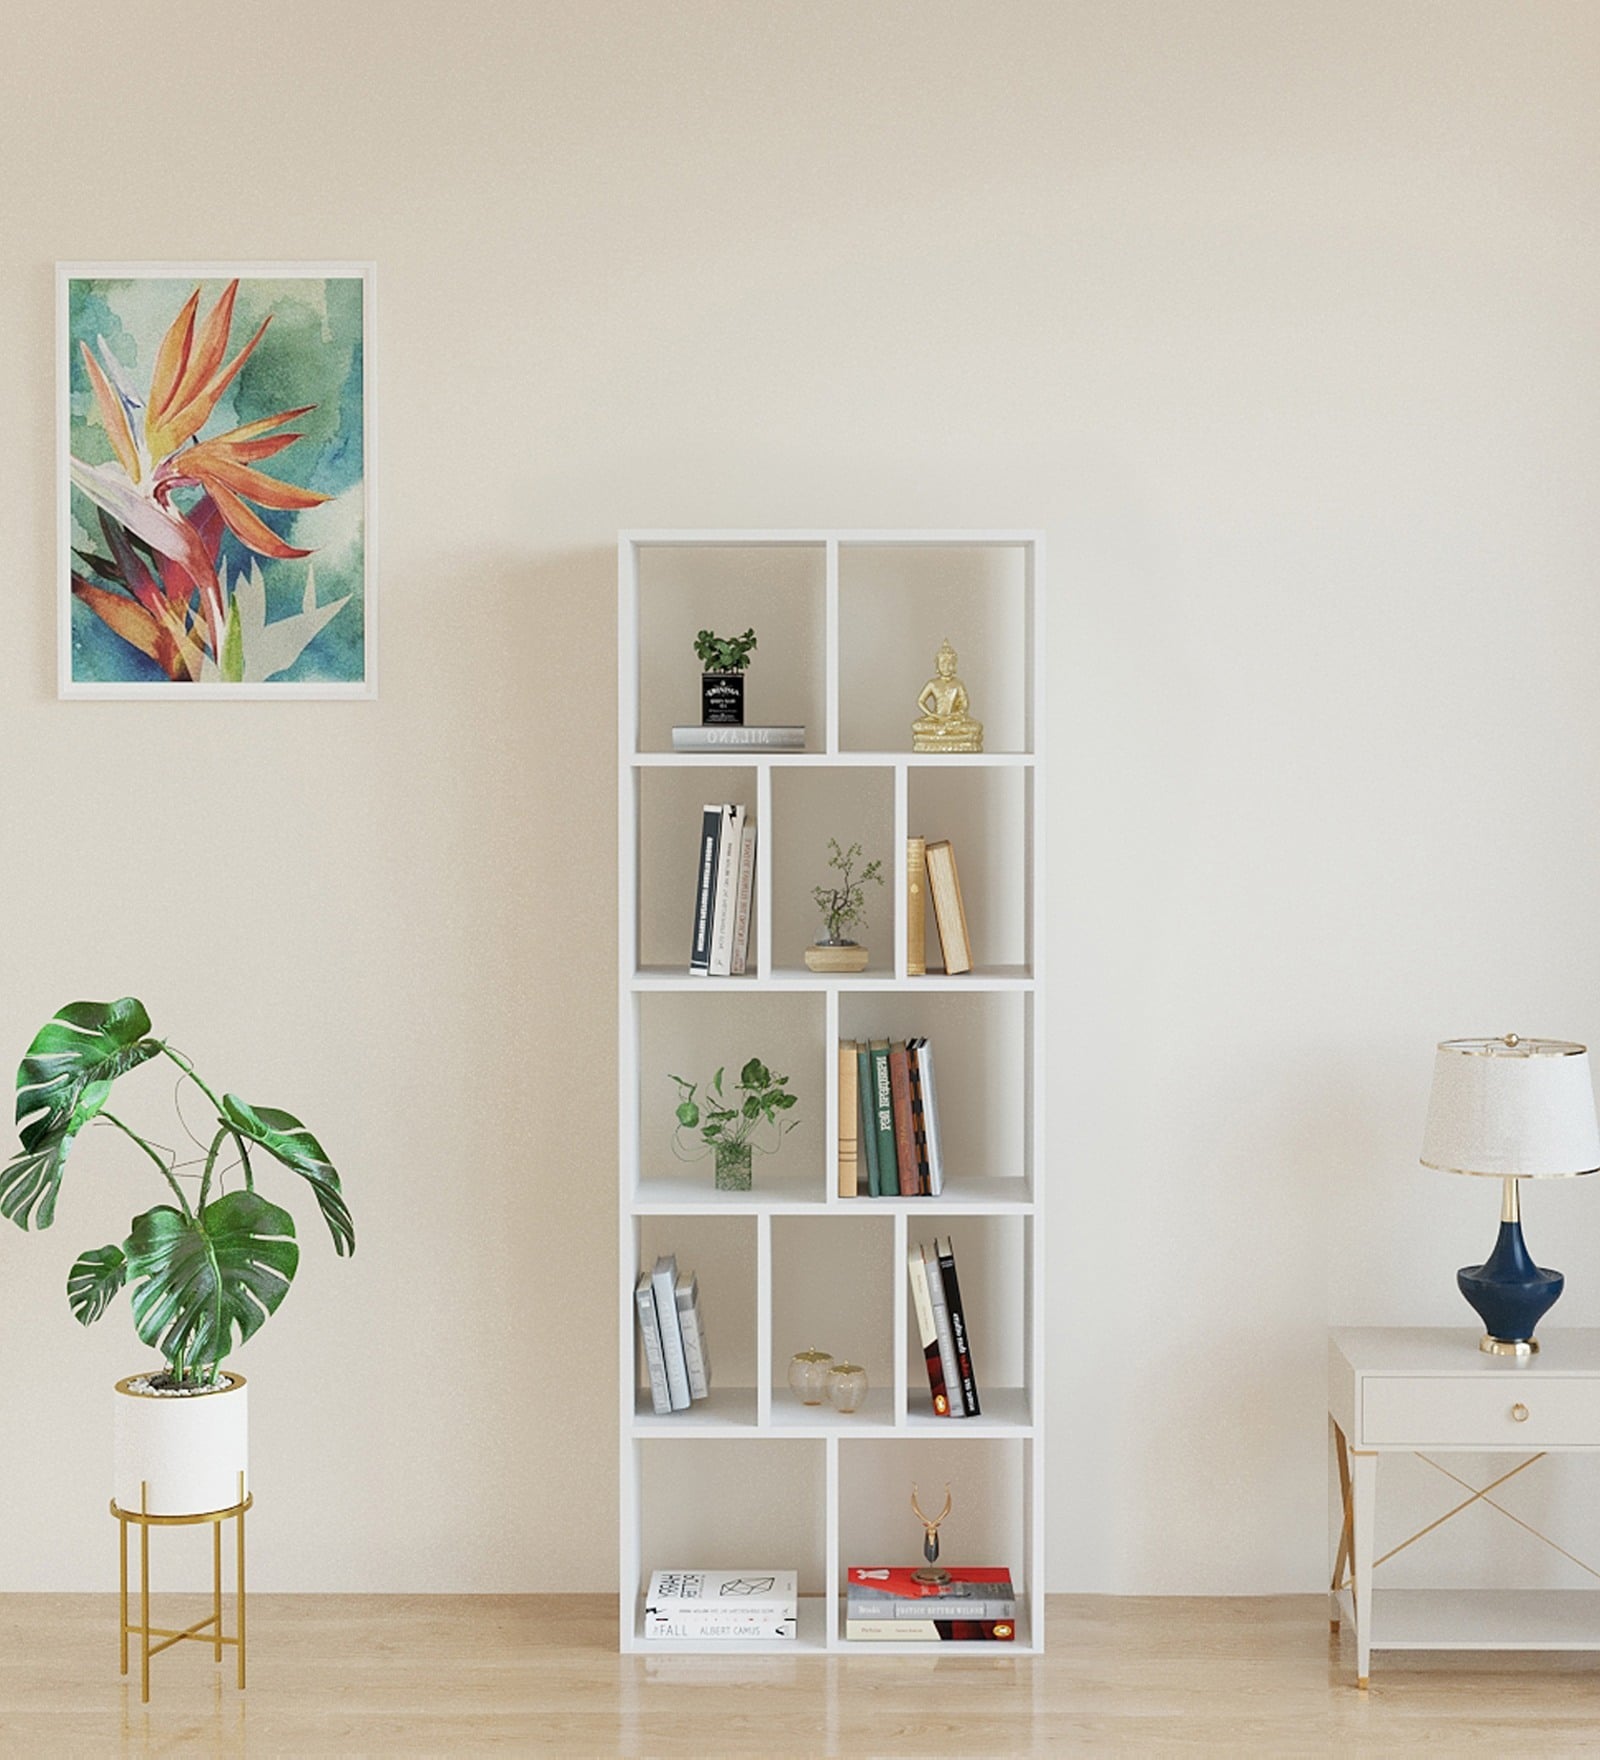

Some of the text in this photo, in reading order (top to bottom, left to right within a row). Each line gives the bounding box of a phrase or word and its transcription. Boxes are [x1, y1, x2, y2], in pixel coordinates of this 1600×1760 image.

[660, 1624, 688, 1637] FALL
[700, 1625, 761, 1636] ALBERT CAMUS
